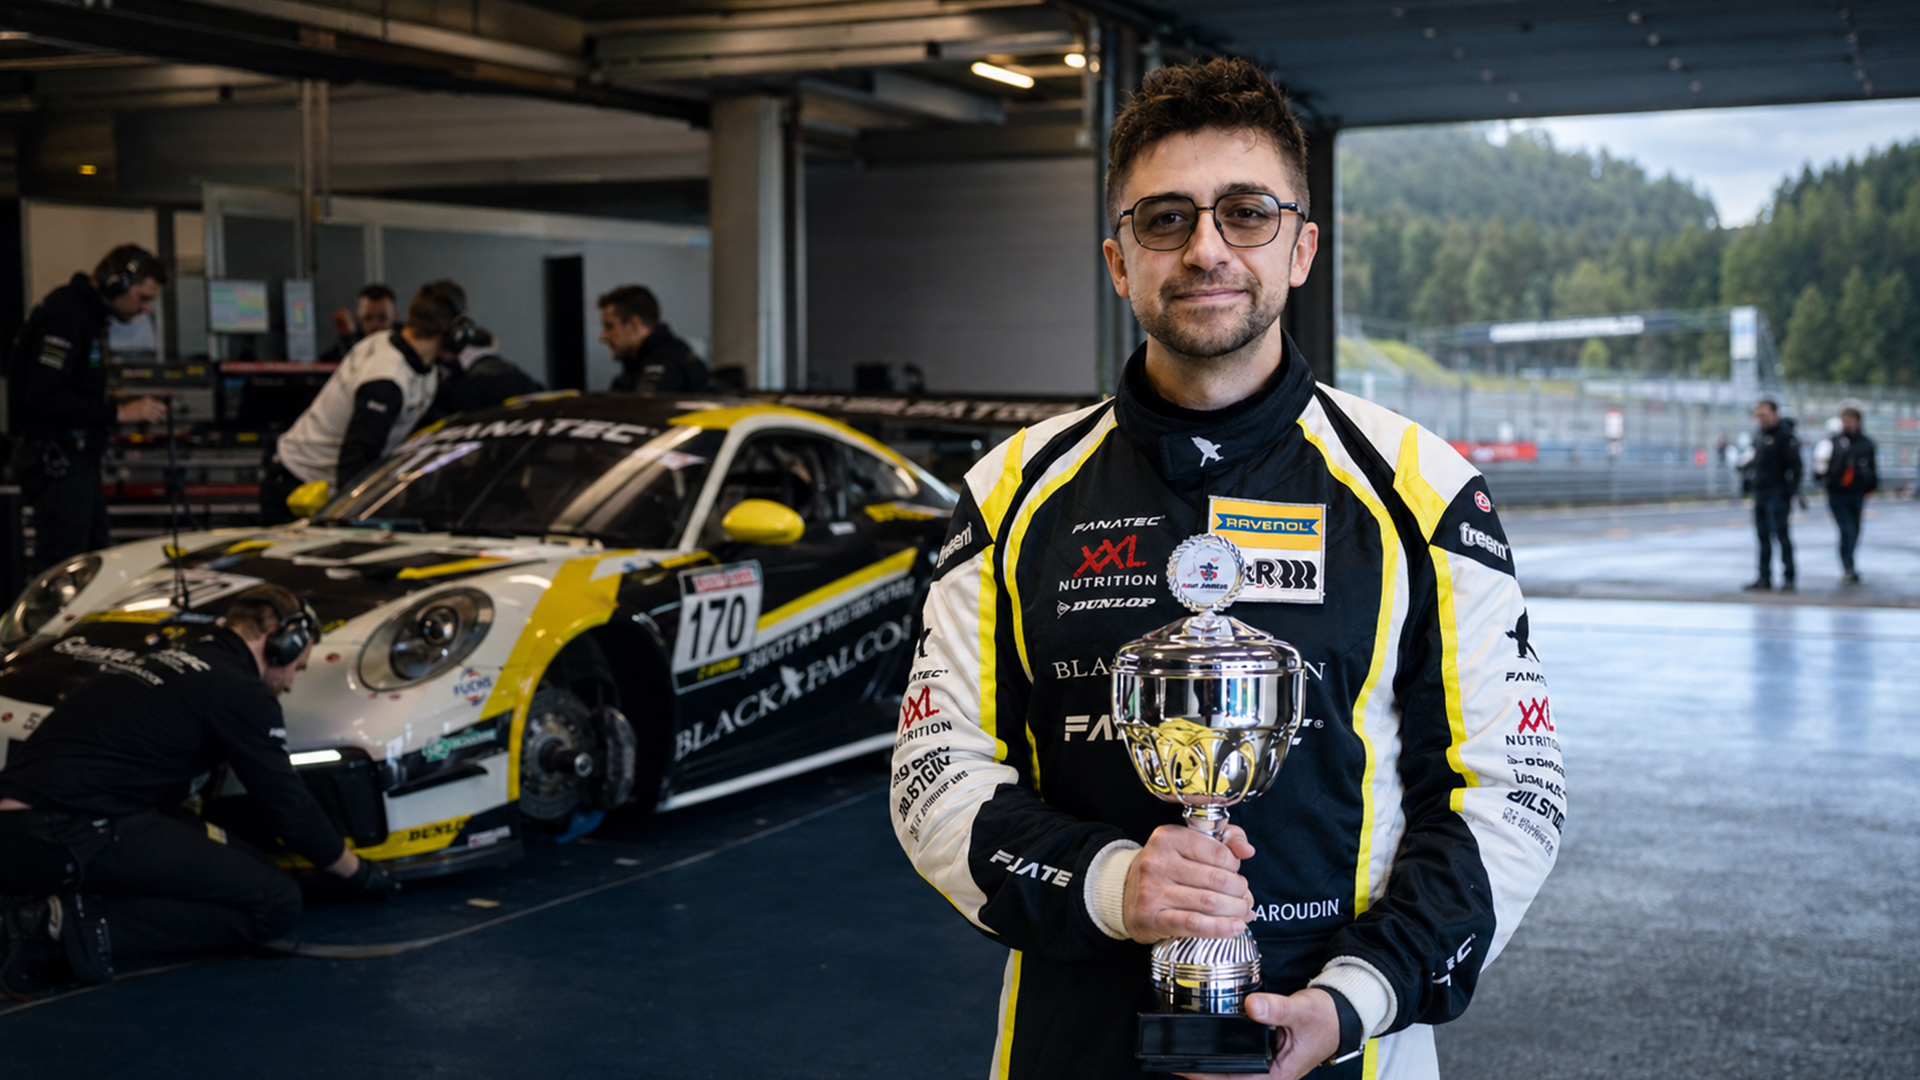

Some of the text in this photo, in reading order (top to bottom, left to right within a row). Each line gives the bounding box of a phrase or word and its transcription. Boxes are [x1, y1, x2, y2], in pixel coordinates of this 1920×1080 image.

[1072, 516, 1161, 534] FANATEC
[1226, 517, 1309, 532] RAVENOL
[1073, 534, 1147, 578] XXL
[1058, 574, 1158, 591] NUTRITION
[1070, 597, 1156, 612] DUNLOP
[688, 594, 747, 661] 170
[1052, 657, 1110, 680] BLA
[674, 682, 781, 762] BLACK
